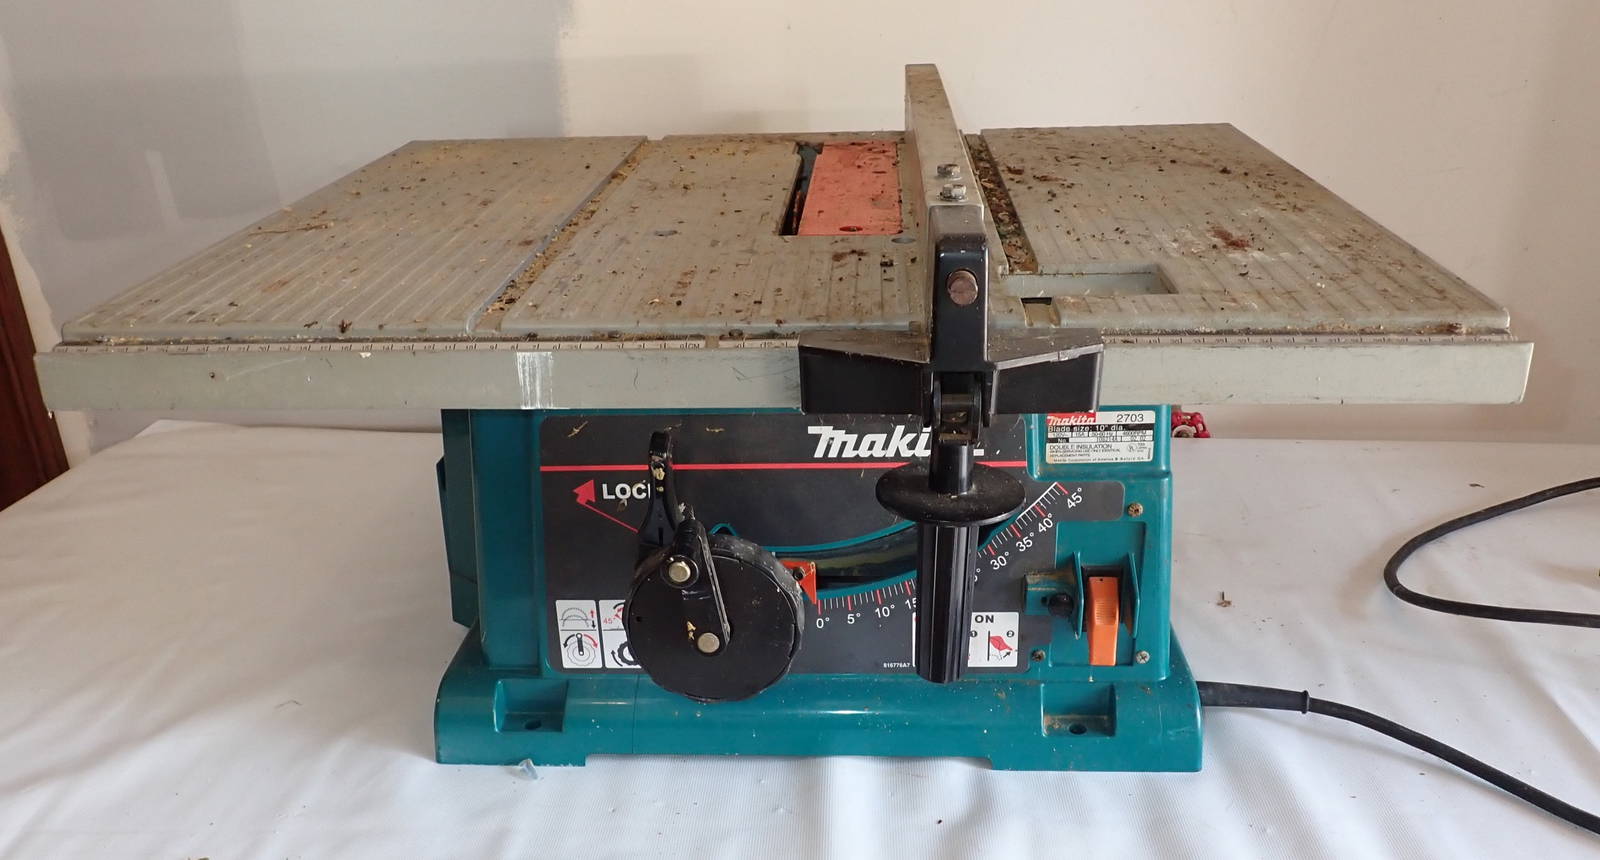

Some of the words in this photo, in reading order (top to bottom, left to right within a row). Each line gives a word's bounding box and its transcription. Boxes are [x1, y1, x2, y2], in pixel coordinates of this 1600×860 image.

[1116, 414, 1144, 423] 2703
[807, 425, 984, 458] Maki
[905, 597, 917, 609] 15
[974, 615, 995, 623] ON
